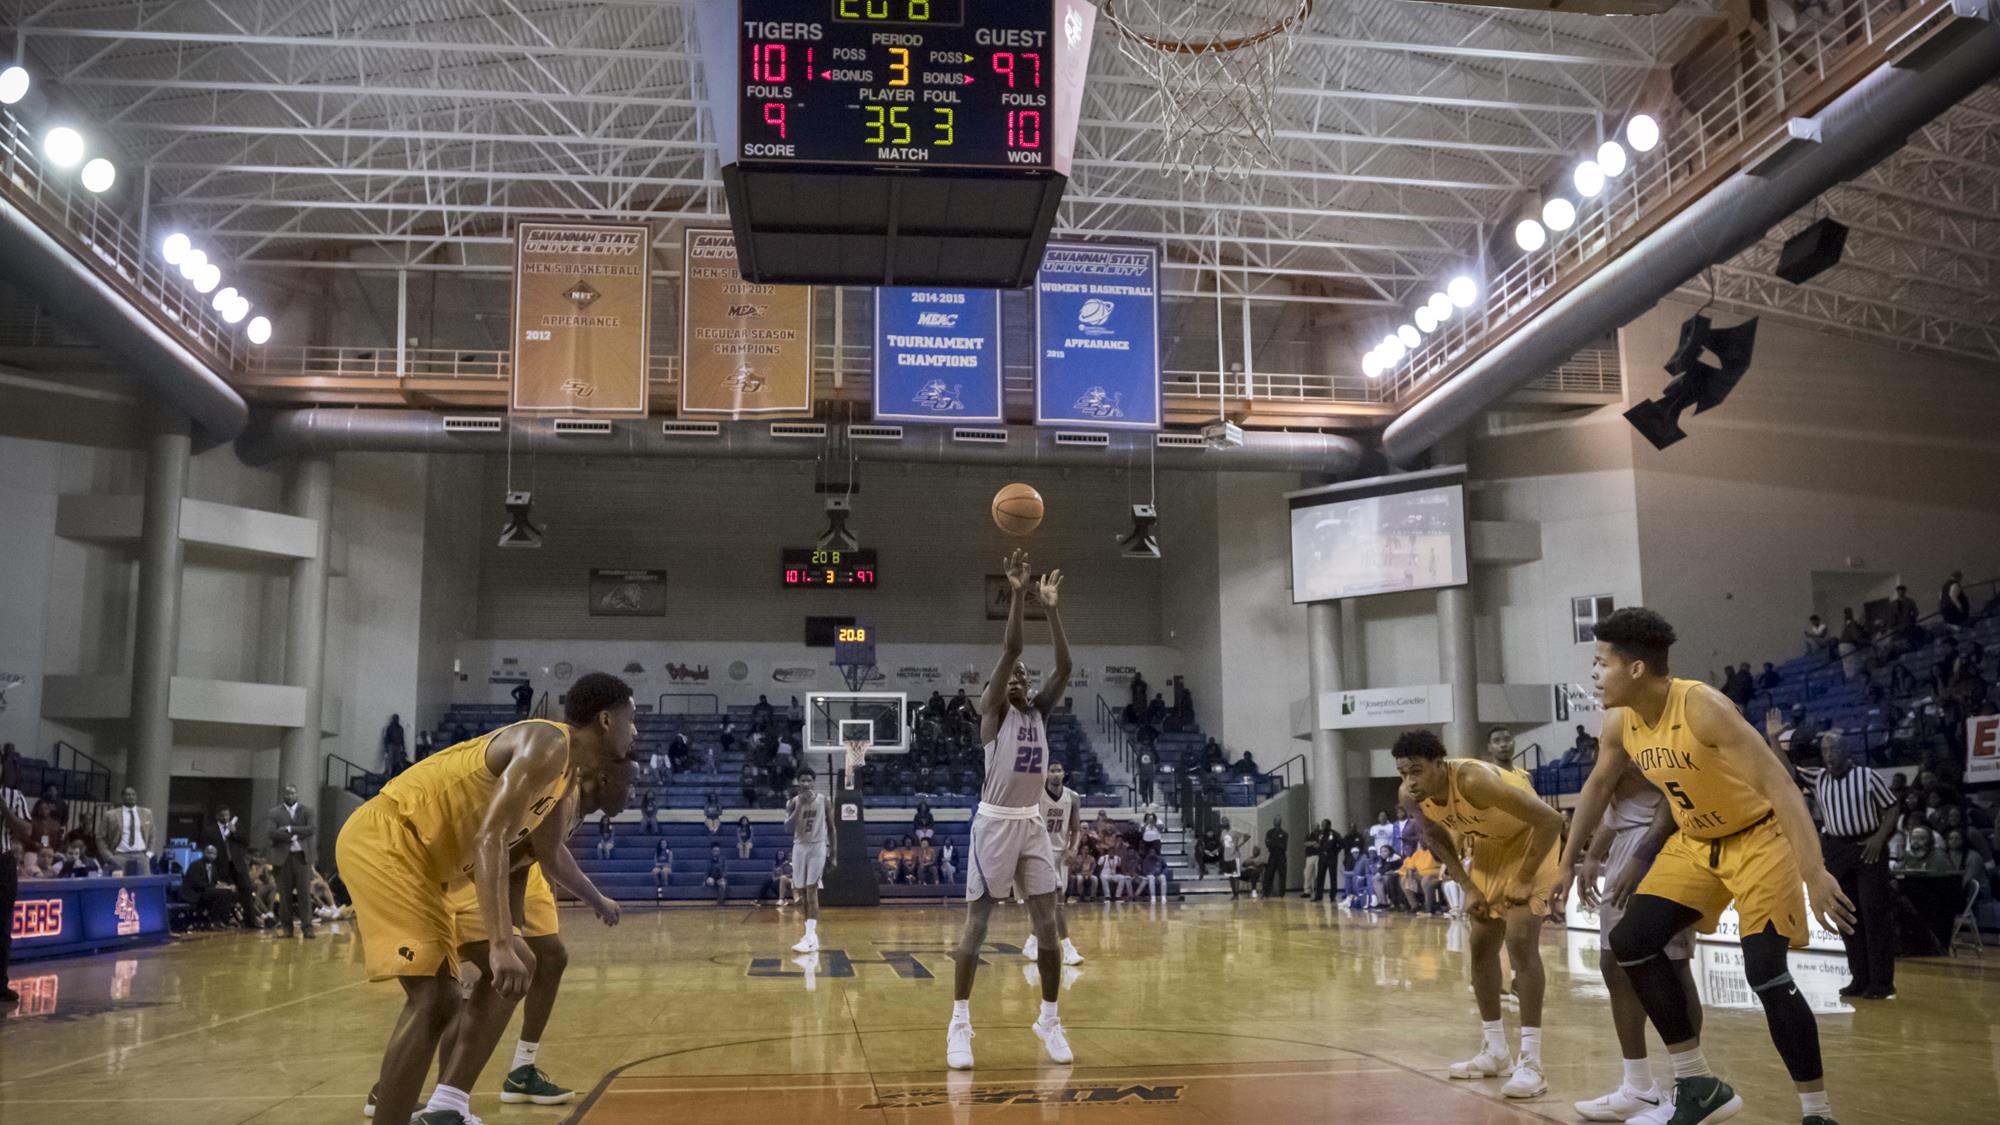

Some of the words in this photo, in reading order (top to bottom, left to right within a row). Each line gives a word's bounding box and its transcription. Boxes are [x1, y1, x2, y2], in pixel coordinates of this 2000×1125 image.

[744, 21, 823, 40] TIGERS
[872, 33, 923, 46] PERIOD
[975, 28, 1047, 47] GUEST
[833, 48, 866, 60] POSS
[930, 52, 963, 64] POSS
[888, 47, 909, 86] 3
[992, 52, 1041, 88] 97
[832, 69, 873, 82] BONUS
[923, 72, 963, 85] BONUS
[747, 85, 792, 98] FOULS
[859, 88, 915, 101] PLAYER
[923, 90, 961, 103] FOUL
[1002, 93, 1046, 106] FOULS
[764, 103, 785, 139] 9
[864, 106, 911, 144] 35
[933, 107, 953, 145] 3
[1008, 110, 1040, 148] 10
[744, 143, 795, 157] SCORE
[878, 148, 929, 161] MATCH
[1008, 151, 1042, 164] WON
[529, 230, 597, 242] SAVANNAH
[598, 233, 640, 244] STATE
[525, 243, 638, 255] UNIVERSITY
[1045, 250, 1108, 262] SAVANNAH
[1109, 254, 1149, 265] STATE
[564, 264, 640, 275] BASKETBALL
[1042, 262, 1148, 275] UNIVERSITY
[1041, 283, 1087, 293] WOMEN'S
[1090, 285, 1153, 297] BASKETBALL
[541, 315, 619, 327] APPEARANCE
[918, 312, 958, 327] MEAC
[526, 330, 551, 340] 2012
[696, 328, 748, 338] REGULAR
[751, 329, 795, 340] SEASON
[714, 344, 780, 354] CHAMPIONS
[887, 335, 984, 350] TOURNAMENT
[1064, 338, 1130, 350] APPEARANCE
[897, 354, 978, 367] CHAMPIONS
[832, 551, 840, 564] 8
[826, 570, 834, 583] 3
[857, 570, 873, 582] 97
[839, 629, 865, 641] 20.8
[1014, 746, 1043, 773] 22
[1634, 746, 1700, 771] NORFOLK
[1665, 781, 1695, 810] 5
[1679, 810, 1728, 832] STATE
